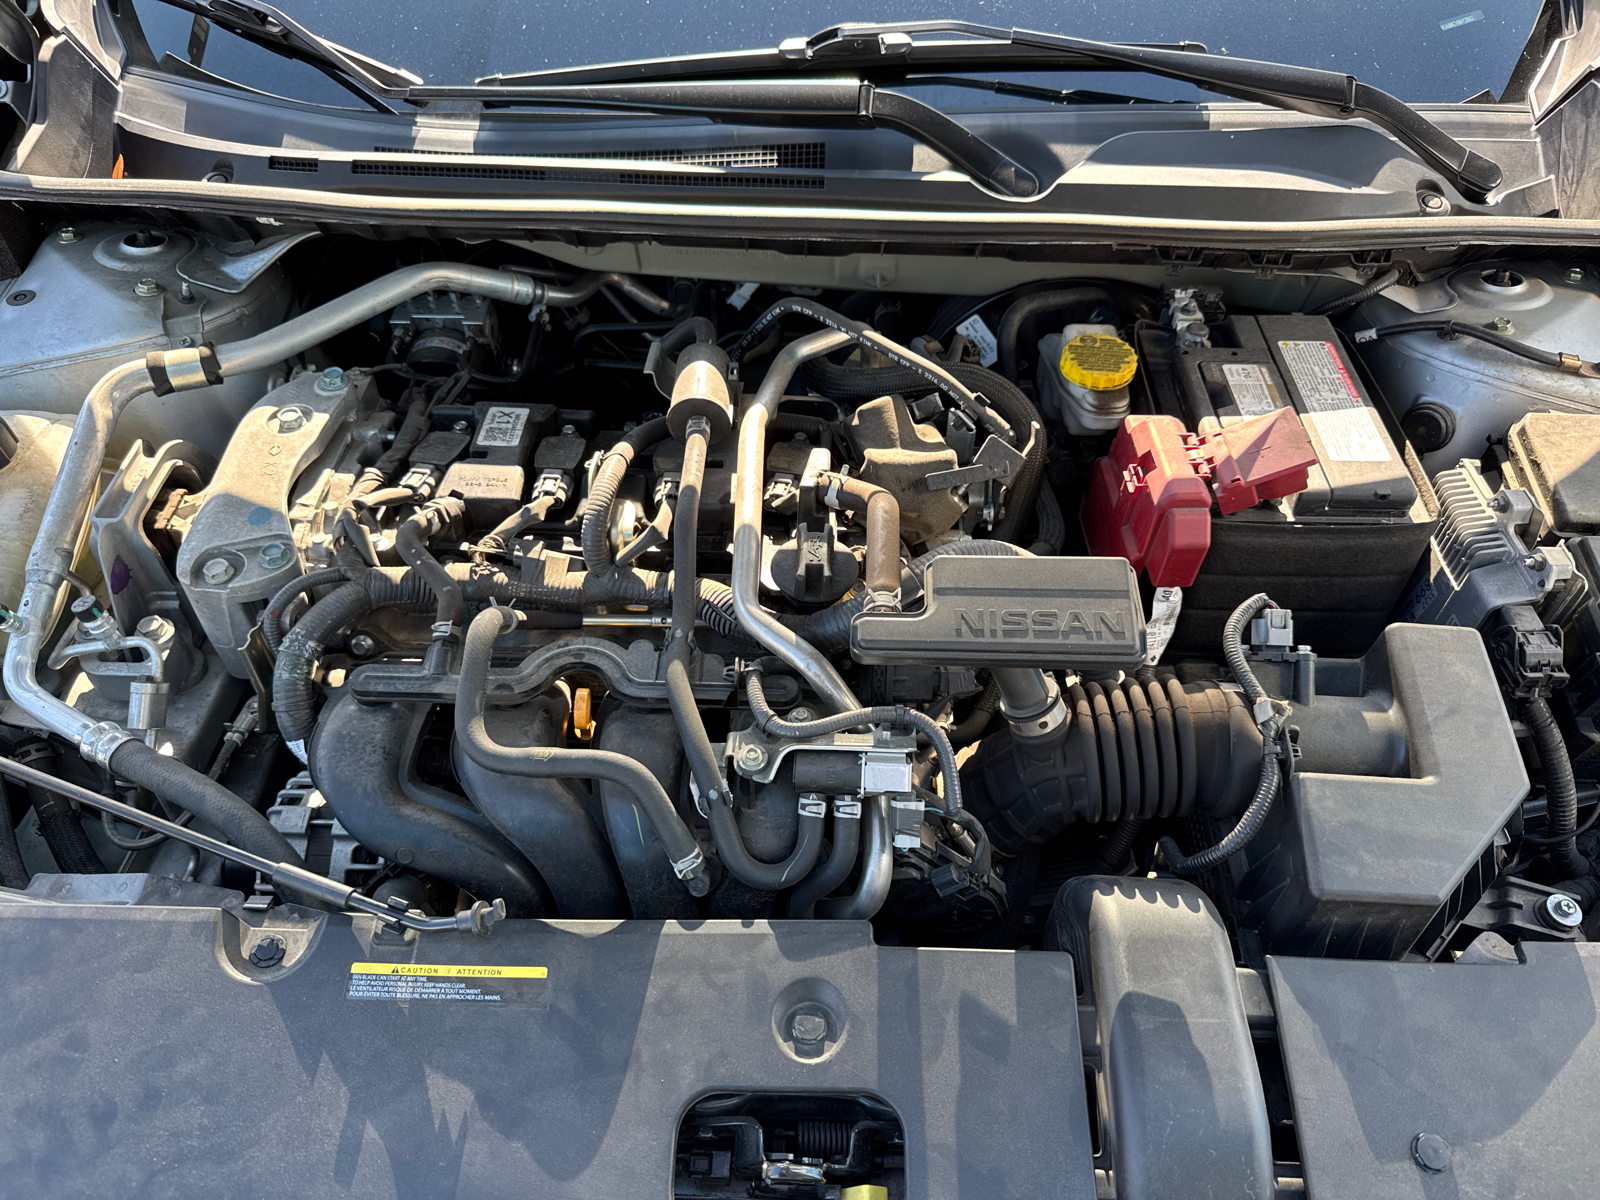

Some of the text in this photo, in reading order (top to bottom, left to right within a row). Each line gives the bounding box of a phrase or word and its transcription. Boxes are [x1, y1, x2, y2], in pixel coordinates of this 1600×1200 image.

[924, 372, 938, 384] 2316
[496, 410, 515, 424] X1
[955, 608, 1126, 640] NISSAN
[400, 966, 439, 974] CAUTION
[456, 968, 503, 976] ATTENTION
